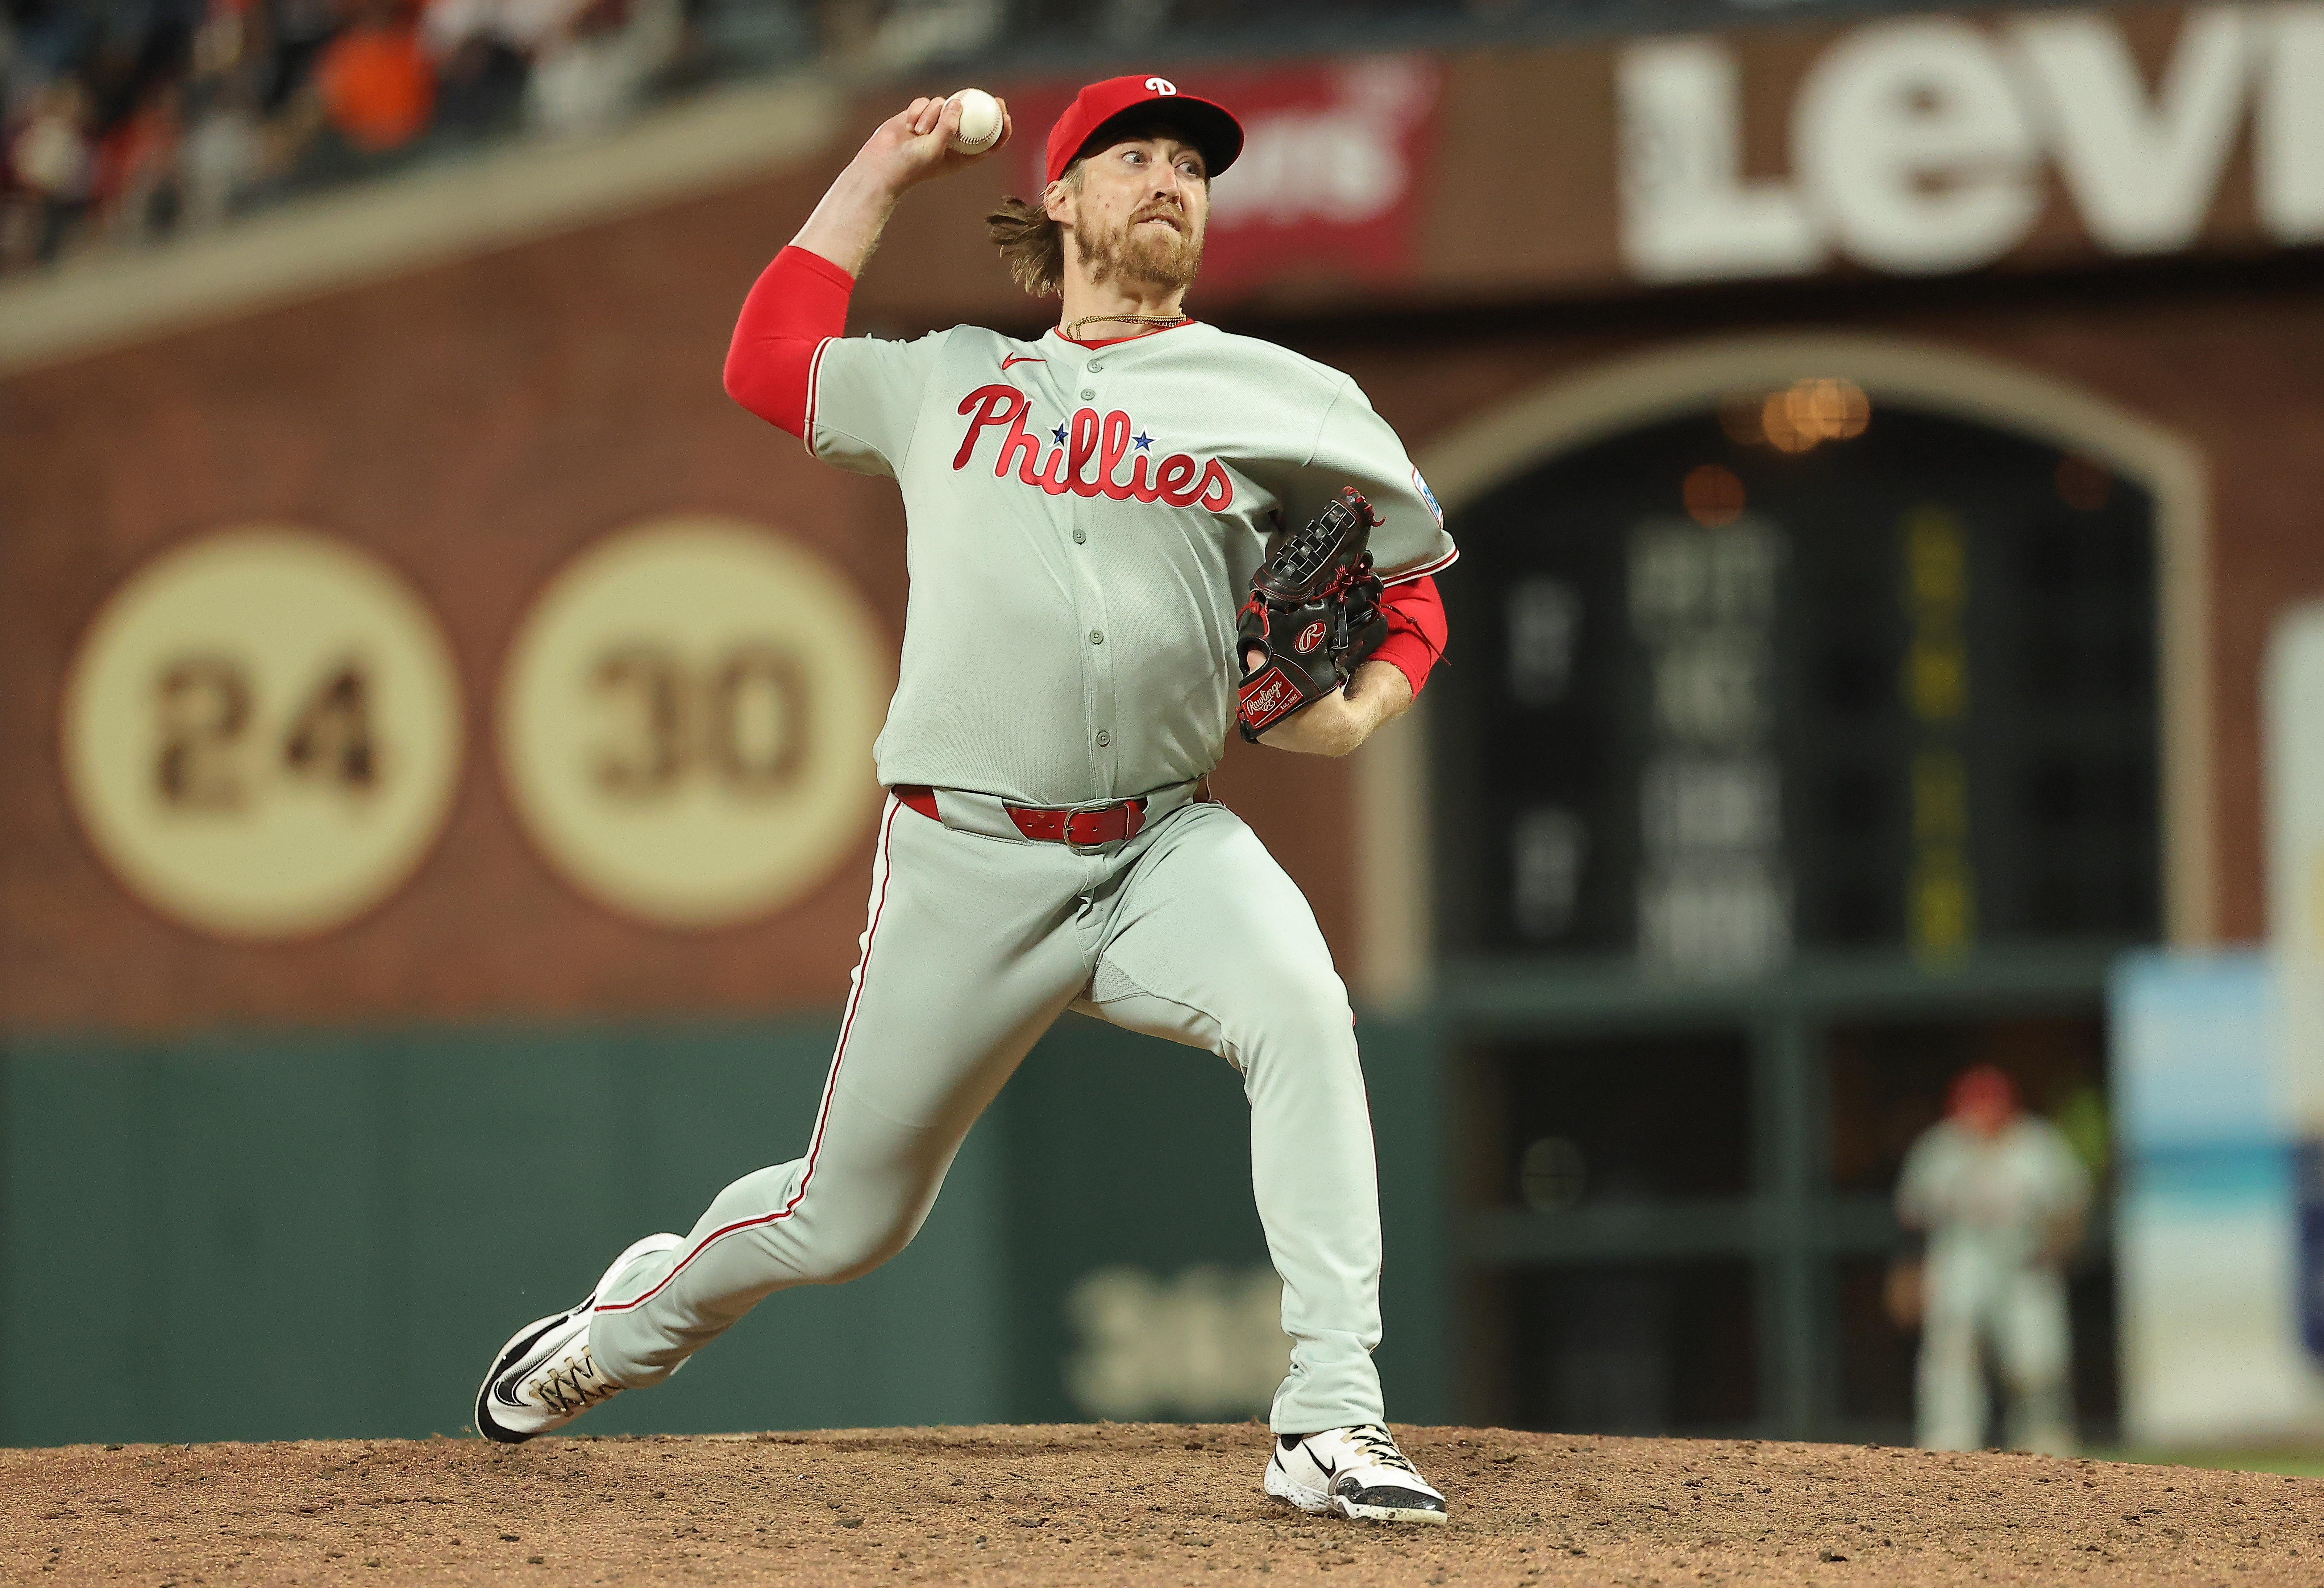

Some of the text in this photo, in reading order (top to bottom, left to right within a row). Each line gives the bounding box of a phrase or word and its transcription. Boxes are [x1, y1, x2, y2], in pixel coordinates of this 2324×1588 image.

[1145, 77, 1177, 96] P
[952, 384, 1233, 513] Phillies
[1299, 624, 1323, 651] R
[1247, 681, 1282, 715] Rawlings
[1288, 693, 1298, 704] 1887
[154, 650, 381, 813] 24
[591, 643, 812, 804] 30
